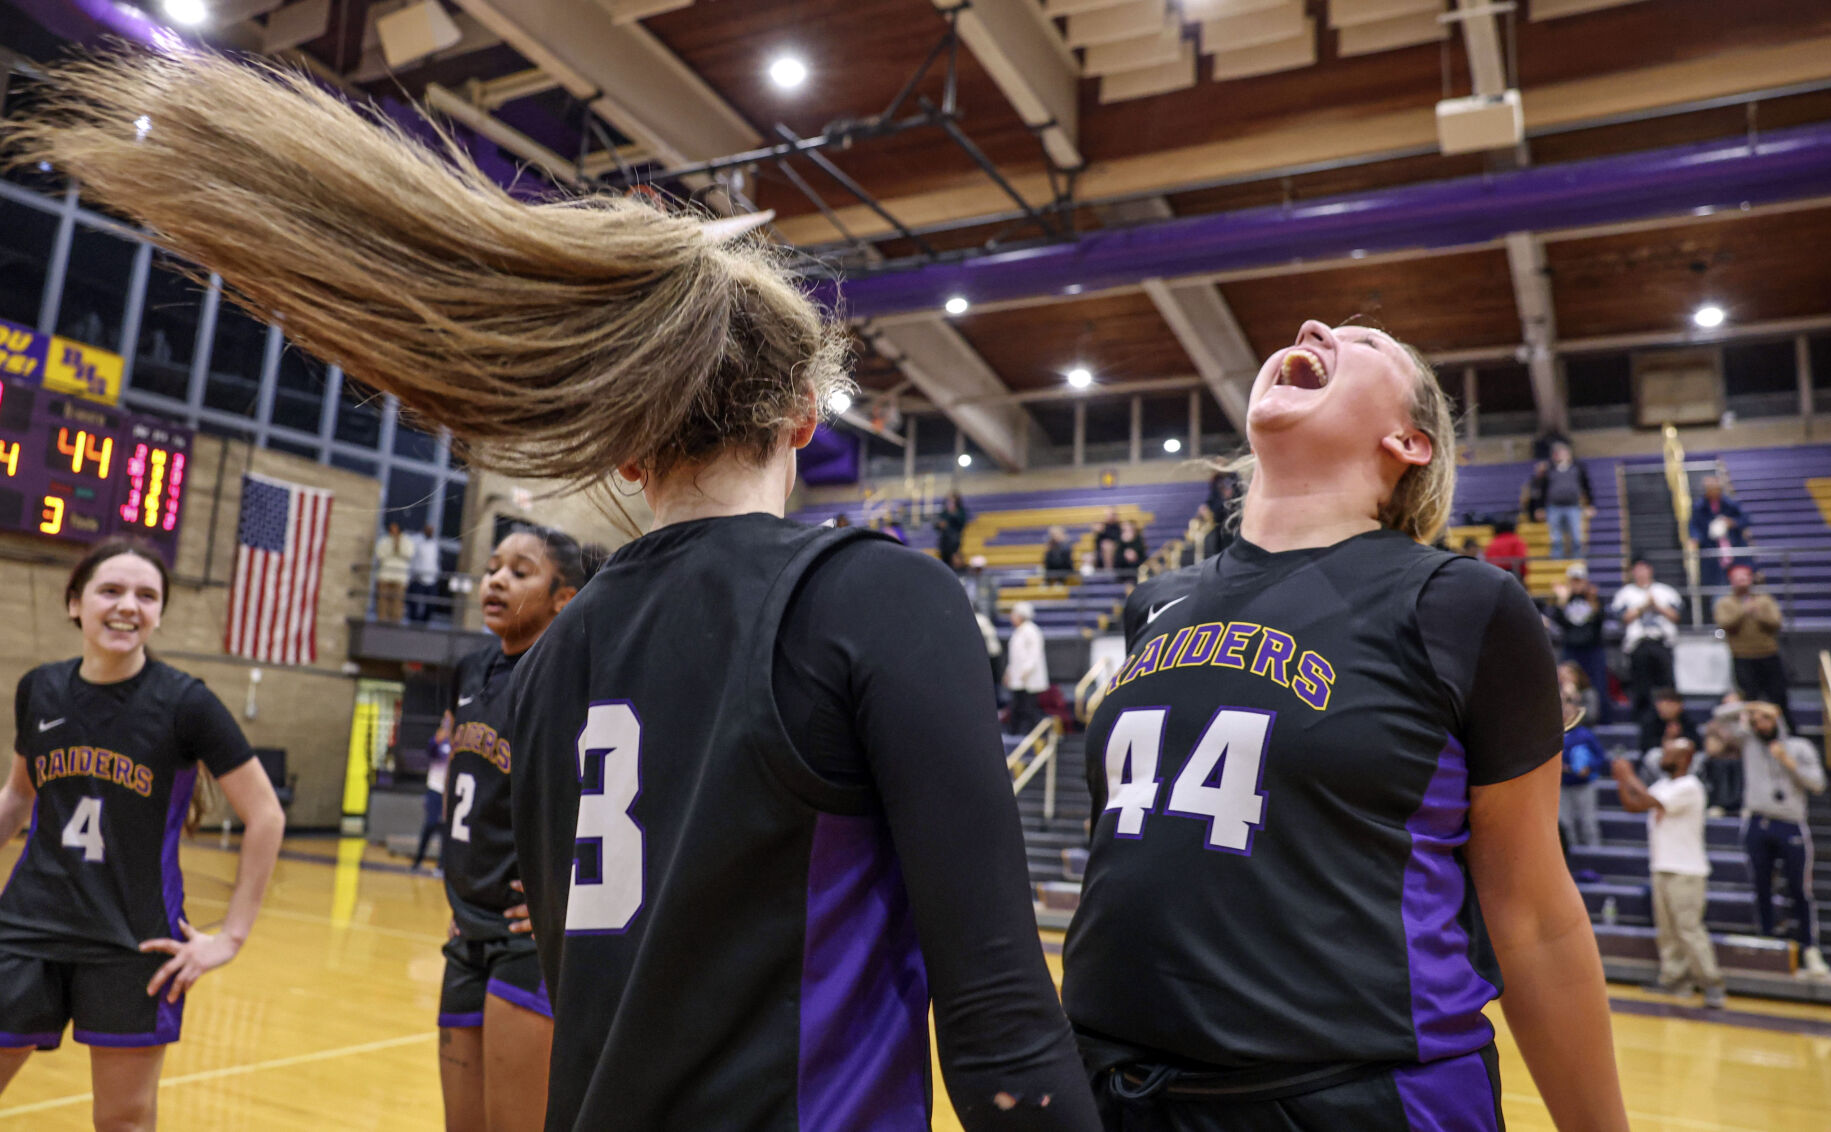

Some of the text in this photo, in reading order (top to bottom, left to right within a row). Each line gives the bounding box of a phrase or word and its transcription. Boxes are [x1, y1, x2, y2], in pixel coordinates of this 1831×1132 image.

[57, 427, 113, 479] 44
[40, 495, 65, 535] 3
[35, 746, 154, 797] RAIDERS
[1103, 705, 1277, 857] 44
[61, 796, 105, 862] 4
[451, 772, 477, 842] 2
[564, 698, 647, 935] 3
